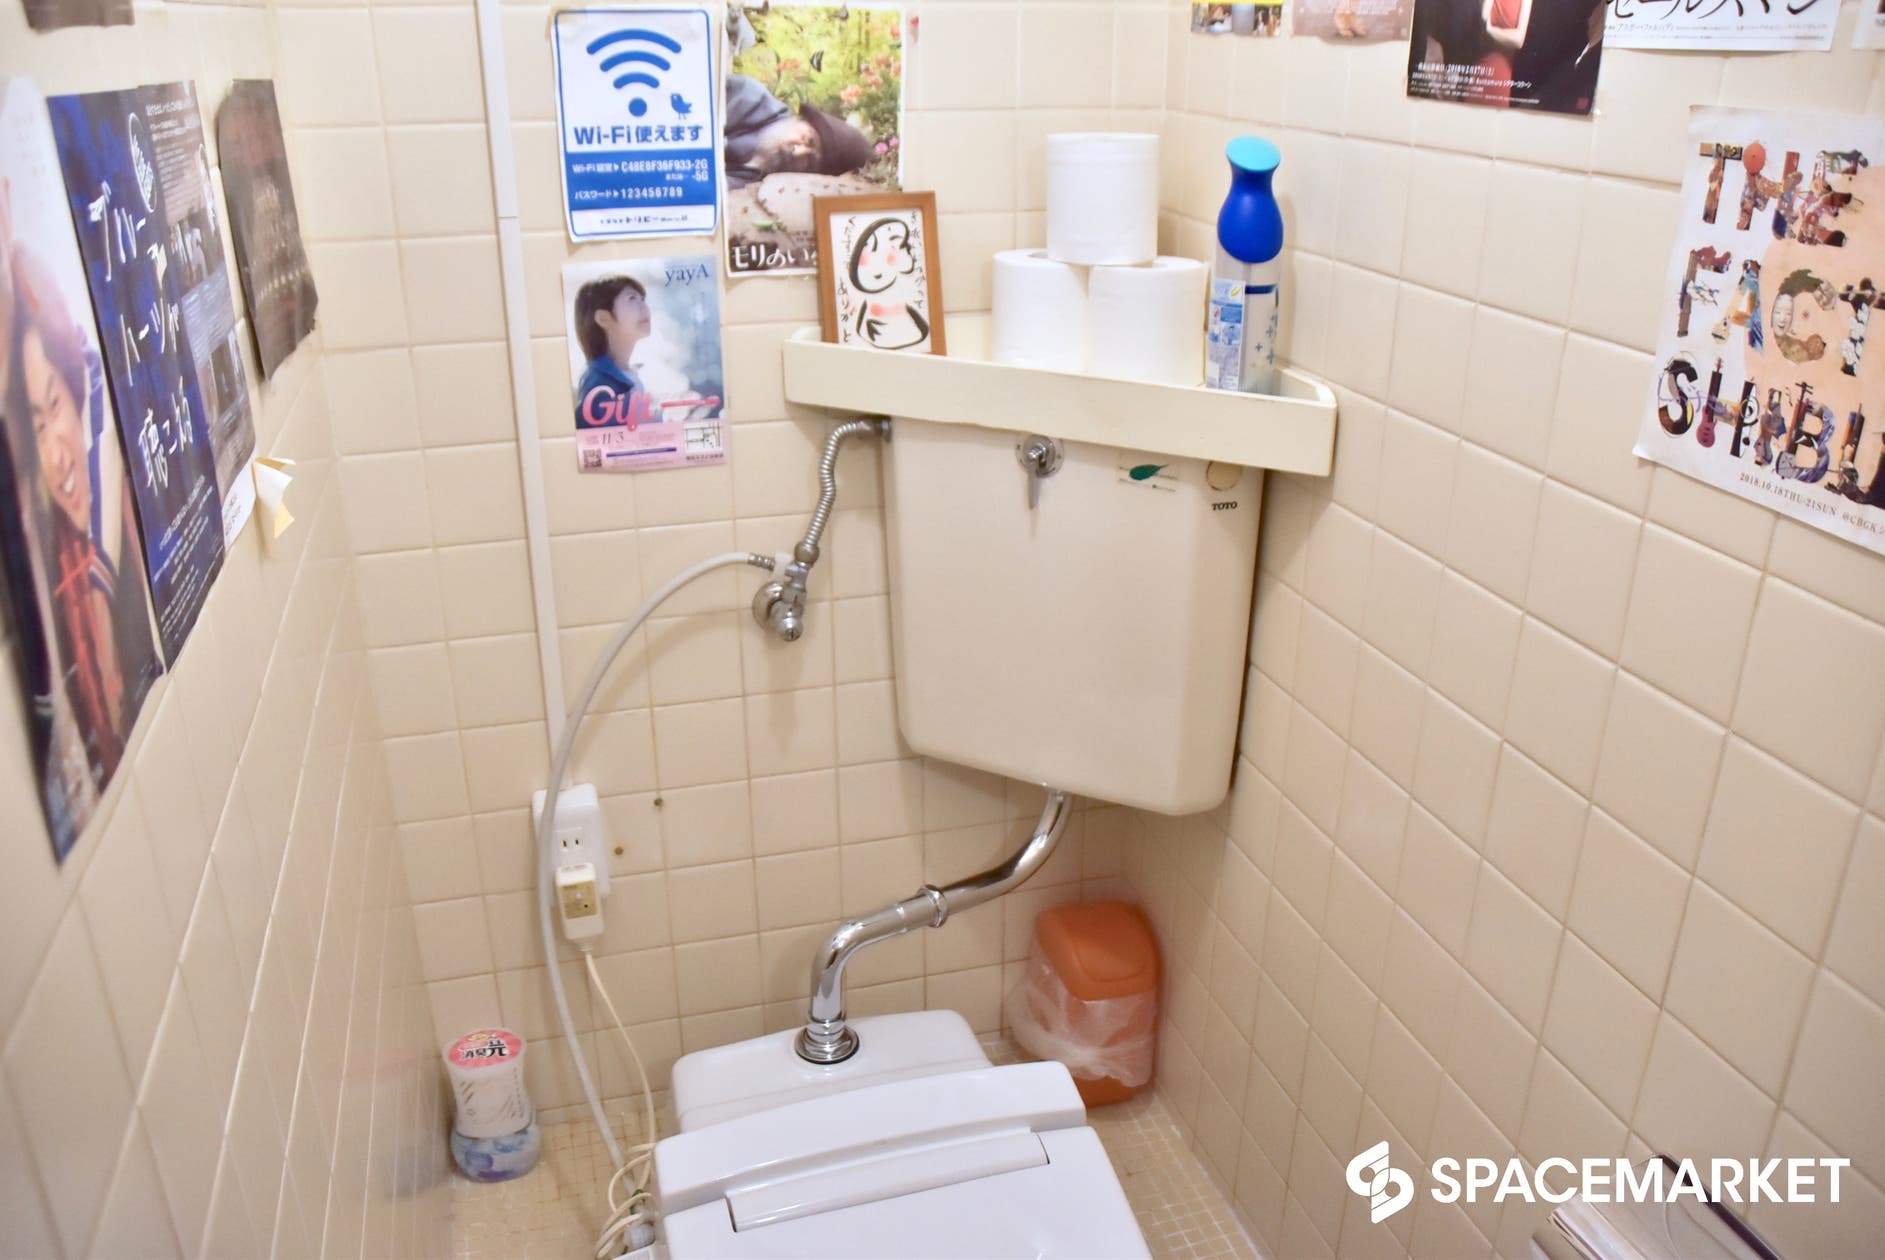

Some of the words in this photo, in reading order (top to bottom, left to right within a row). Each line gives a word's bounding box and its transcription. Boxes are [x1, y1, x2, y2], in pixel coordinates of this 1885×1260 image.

[573, 125, 704, 145] Wi-Fi使えます
[620, 185, 684, 200] 123456789
[1699, 140, 1869, 248] THE
[665, 263, 710, 287] yayA
[1677, 245, 1885, 377] FACT
[1211, 501, 1238, 511] TOTO
